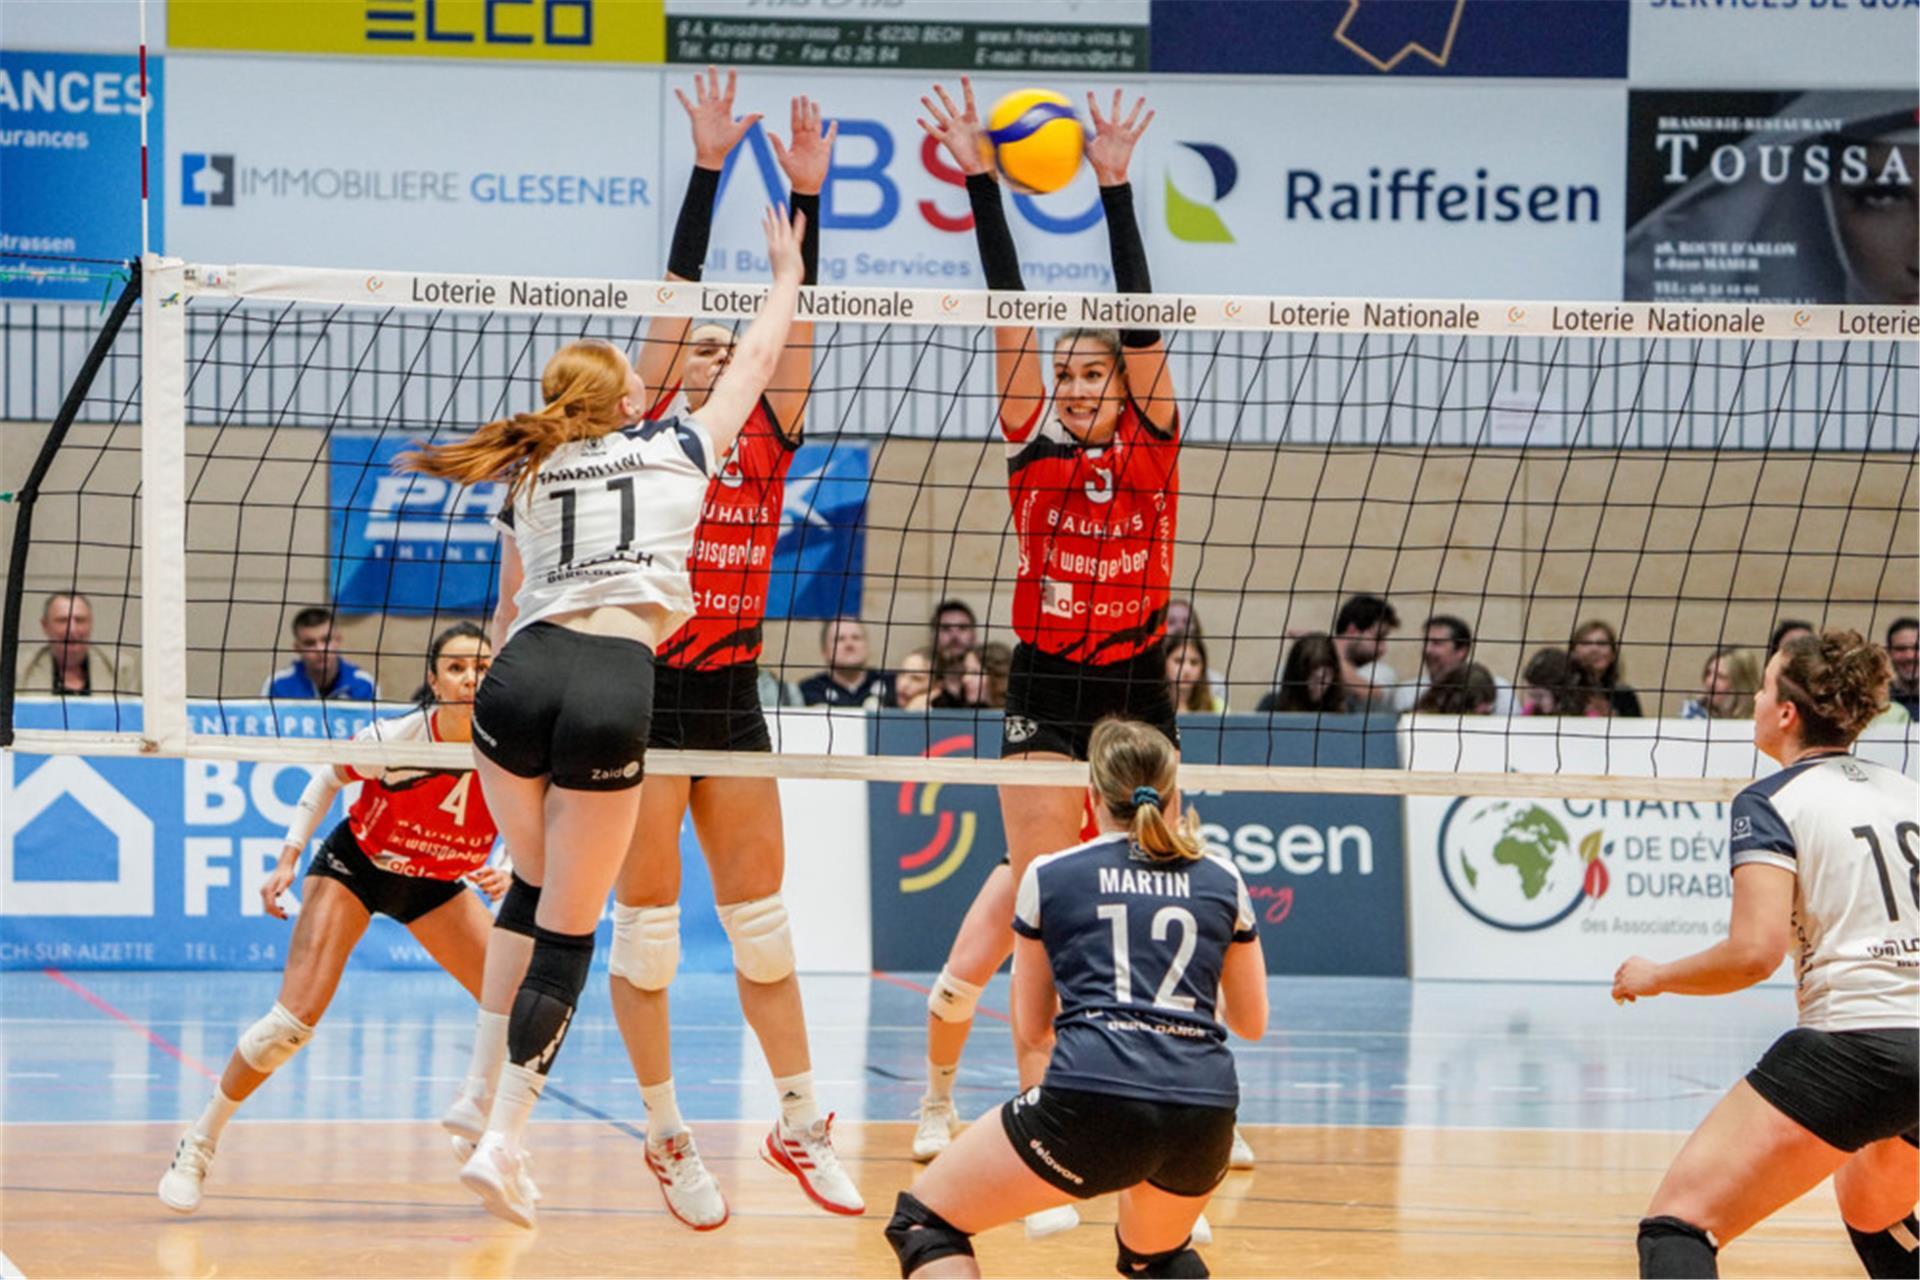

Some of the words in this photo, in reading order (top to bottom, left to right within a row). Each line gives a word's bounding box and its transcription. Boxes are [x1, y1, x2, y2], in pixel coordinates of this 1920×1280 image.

[240, 166, 460, 201] IMMOBILIERE
[469, 173, 650, 207] GLESENER
[1286, 167, 1601, 223] Raiffeisen
[855, 252, 971, 277] Services
[412, 277, 496, 305] Loterie
[509, 280, 628, 309] Nationale
[701, 286, 768, 313] Loteri
[797, 290, 914, 318] Nationale
[985, 294, 1067, 322] Loterie
[1080, 296, 1198, 324] Nationale
[1268, 300, 1351, 327] Loterie
[1363, 302, 1480, 329] Nationale
[1552, 305, 1635, 332] Loterie
[1647, 306, 1766, 333] Nationale
[1838, 309, 1919, 336] Loterie
[549, 476, 636, 566] 11
[437, 771, 474, 827] 4
[1624, 835, 1662, 862] DE
[1098, 867, 1191, 899] MARTIN
[1097, 903, 1199, 1013] 12
[1029, 1138, 1085, 1186] delaware
